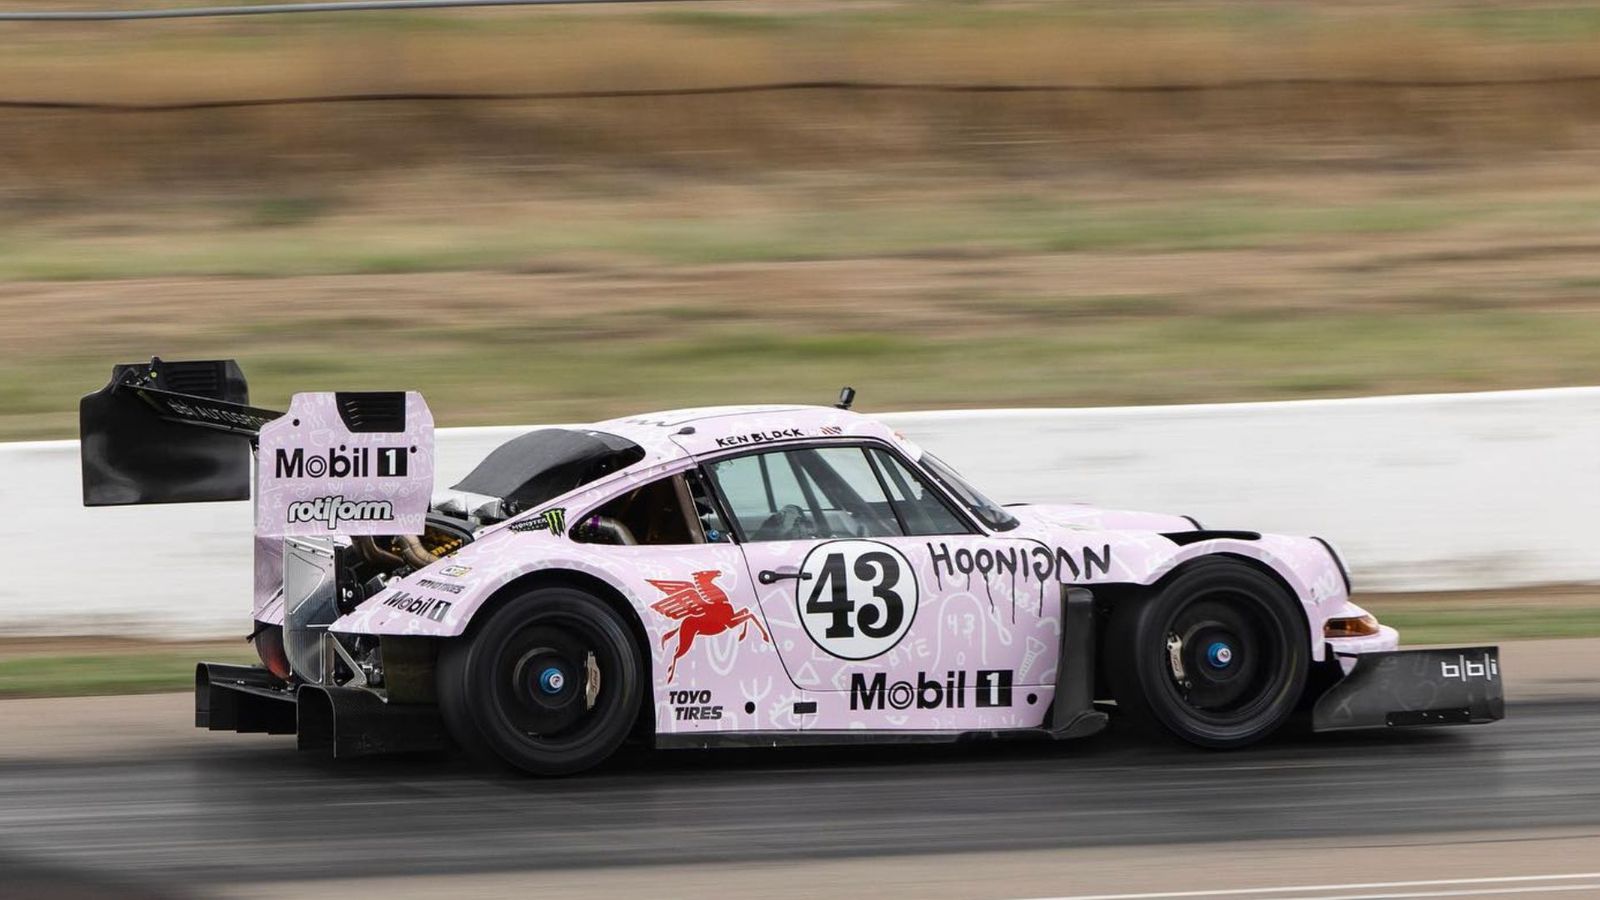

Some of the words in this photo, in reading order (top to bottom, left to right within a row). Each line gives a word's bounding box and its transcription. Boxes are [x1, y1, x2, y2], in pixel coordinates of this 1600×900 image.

[715, 434, 749, 447] KEN
[751, 428, 804, 443] BLOCK
[275, 447, 369, 478] Mobil
[287, 495, 394, 530] rotiform
[926, 542, 1110, 598] HOONIGAN
[382, 590, 435, 617] Mobil
[806, 551, 905, 639] 43
[668, 690, 712, 704] TOYO
[850, 670, 966, 710] Mobil
[675, 705, 723, 720] TIRES
